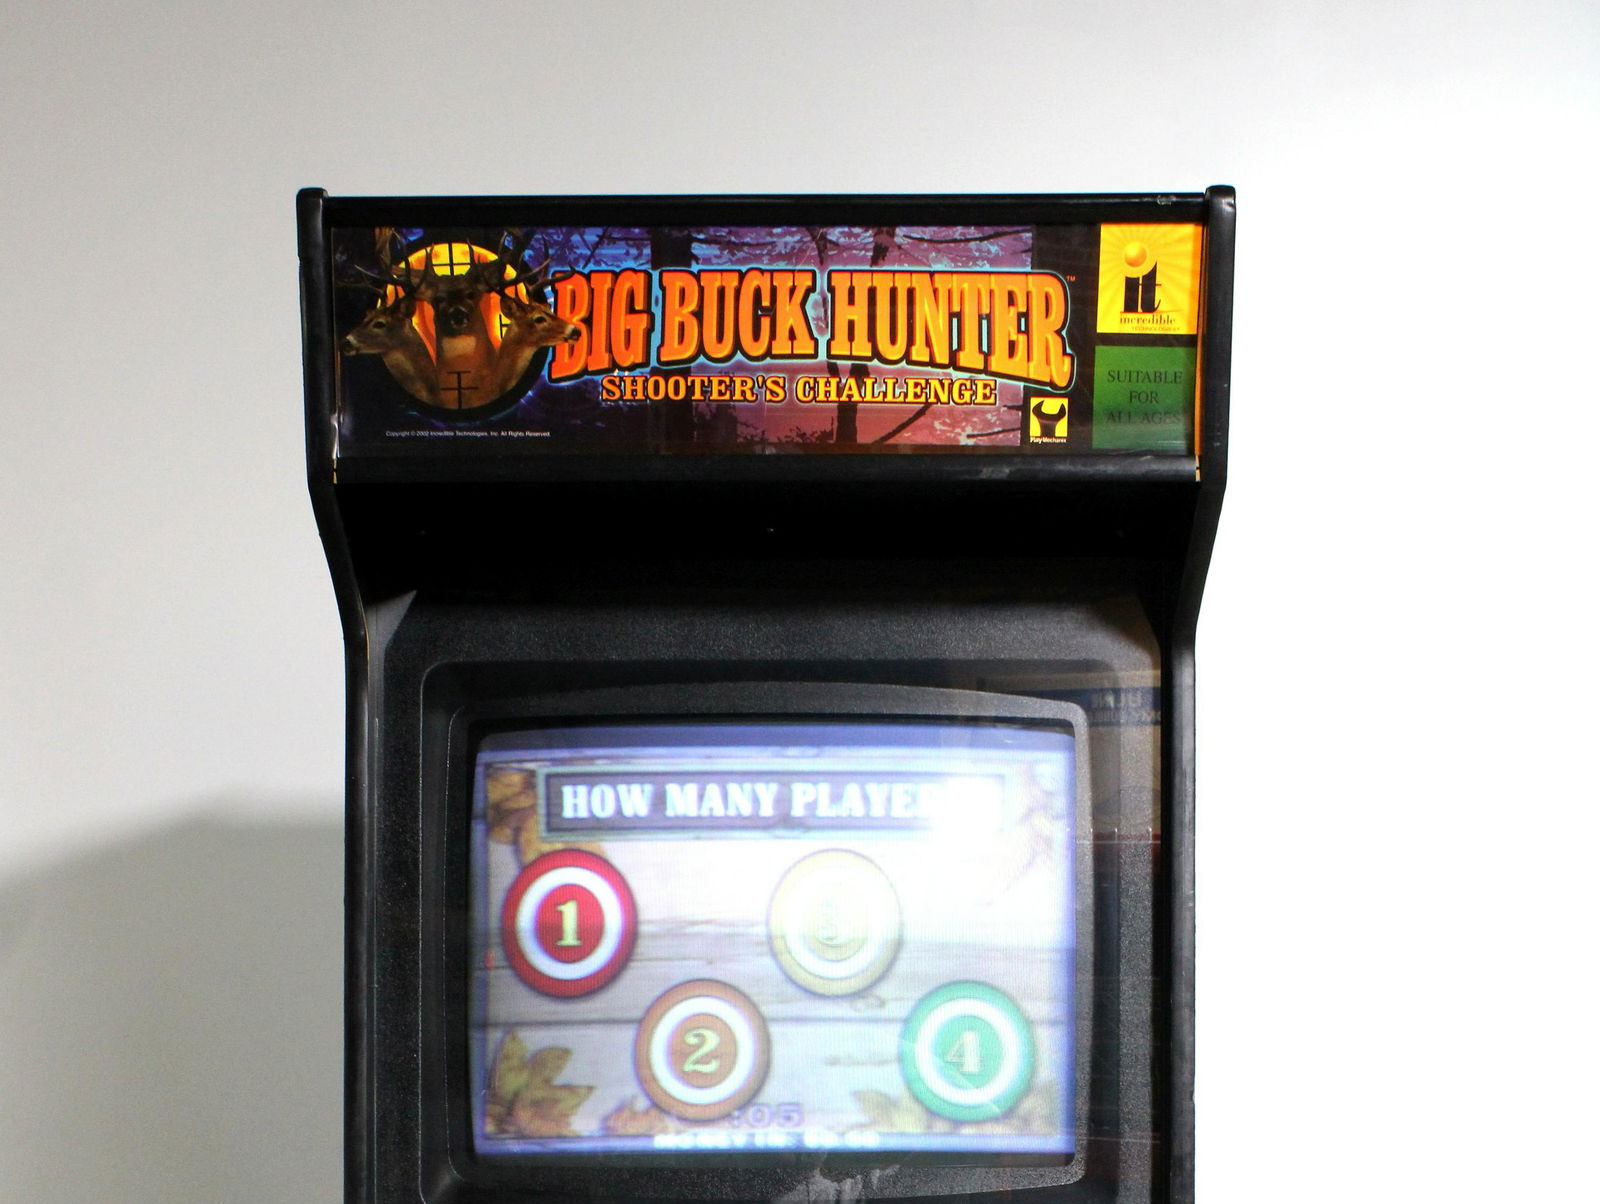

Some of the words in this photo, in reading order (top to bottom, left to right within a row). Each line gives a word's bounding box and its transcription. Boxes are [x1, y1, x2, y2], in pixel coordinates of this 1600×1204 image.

[550, 269, 650, 381] BIG
[659, 270, 818, 364] BUCK
[828, 270, 1071, 388] HUNTER
[1120, 311, 1176, 324] incredible
[602, 375, 785, 401] SHOOTER'S
[796, 376, 998, 404] CHALLENGE
[1107, 370, 1183, 383] SUITABLE
[1129, 391, 1159, 404] FOR
[1106, 412, 1132, 425] ALL
[1140, 412, 1181, 425] AGES
[562, 784, 652, 819] HOW
[666, 783, 779, 819] MANY
[556, 900, 582, 947] 1
[682, 1029, 721, 1073] 2
[943, 1030, 982, 1075] 4
